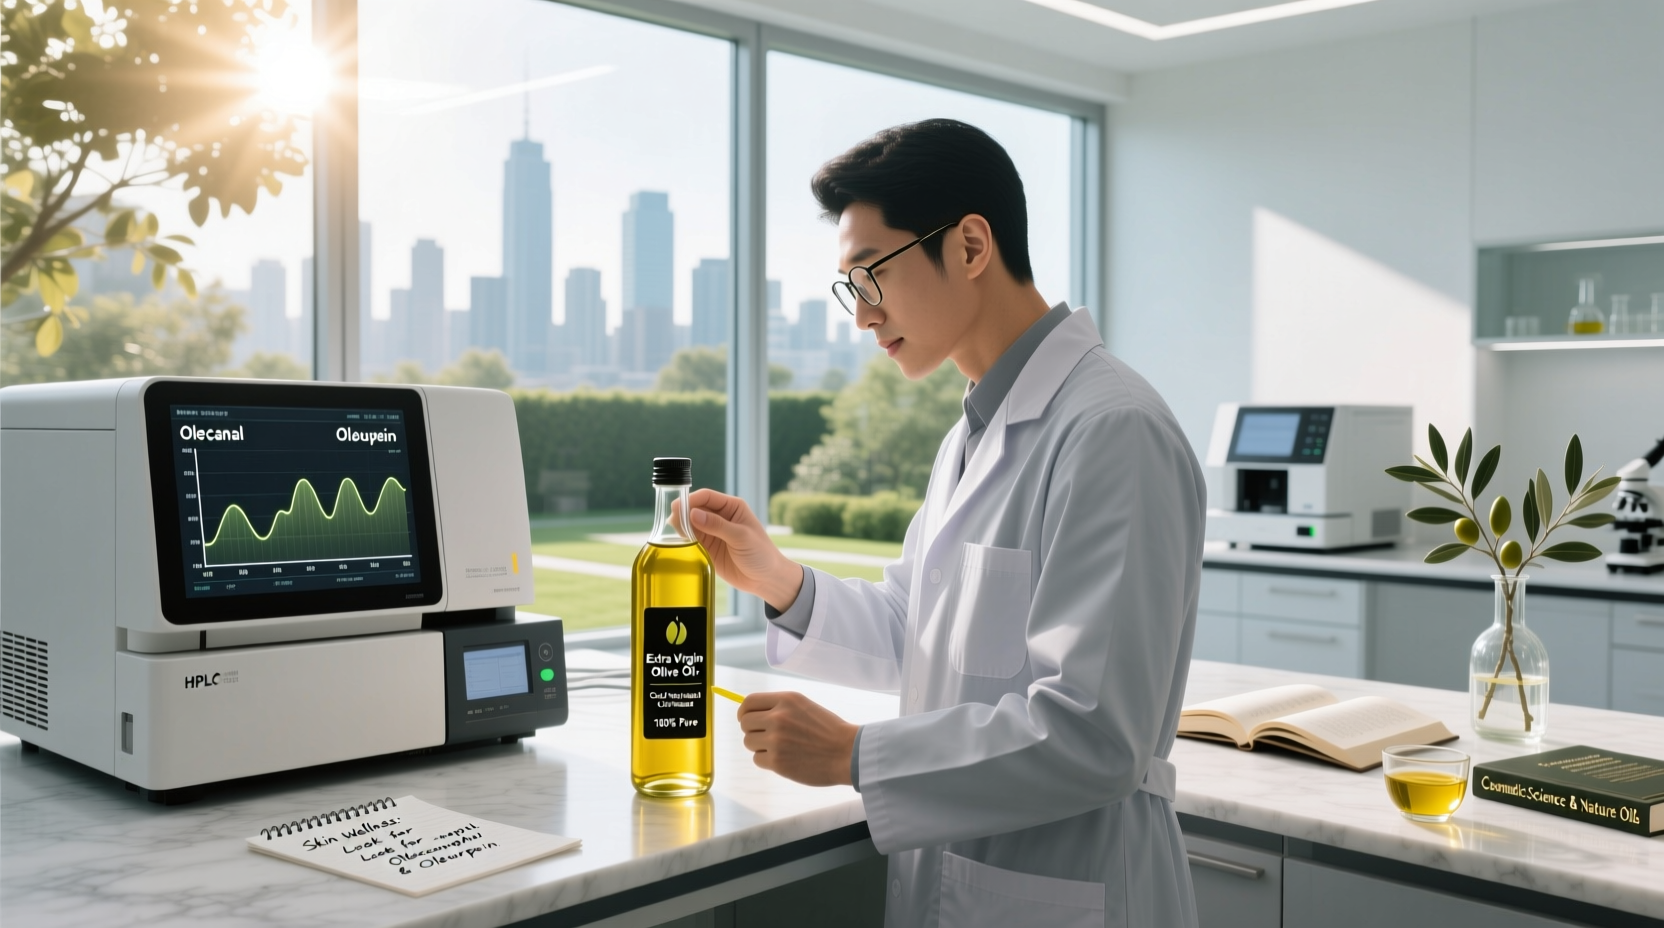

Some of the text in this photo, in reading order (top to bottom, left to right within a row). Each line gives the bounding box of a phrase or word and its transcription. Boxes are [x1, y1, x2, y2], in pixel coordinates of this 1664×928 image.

[185, 672, 221, 689] HPLC
[679, 717, 699, 728] Pure
[1580, 798, 1617, 819] Nature
[303, 836, 338, 851] Skin
